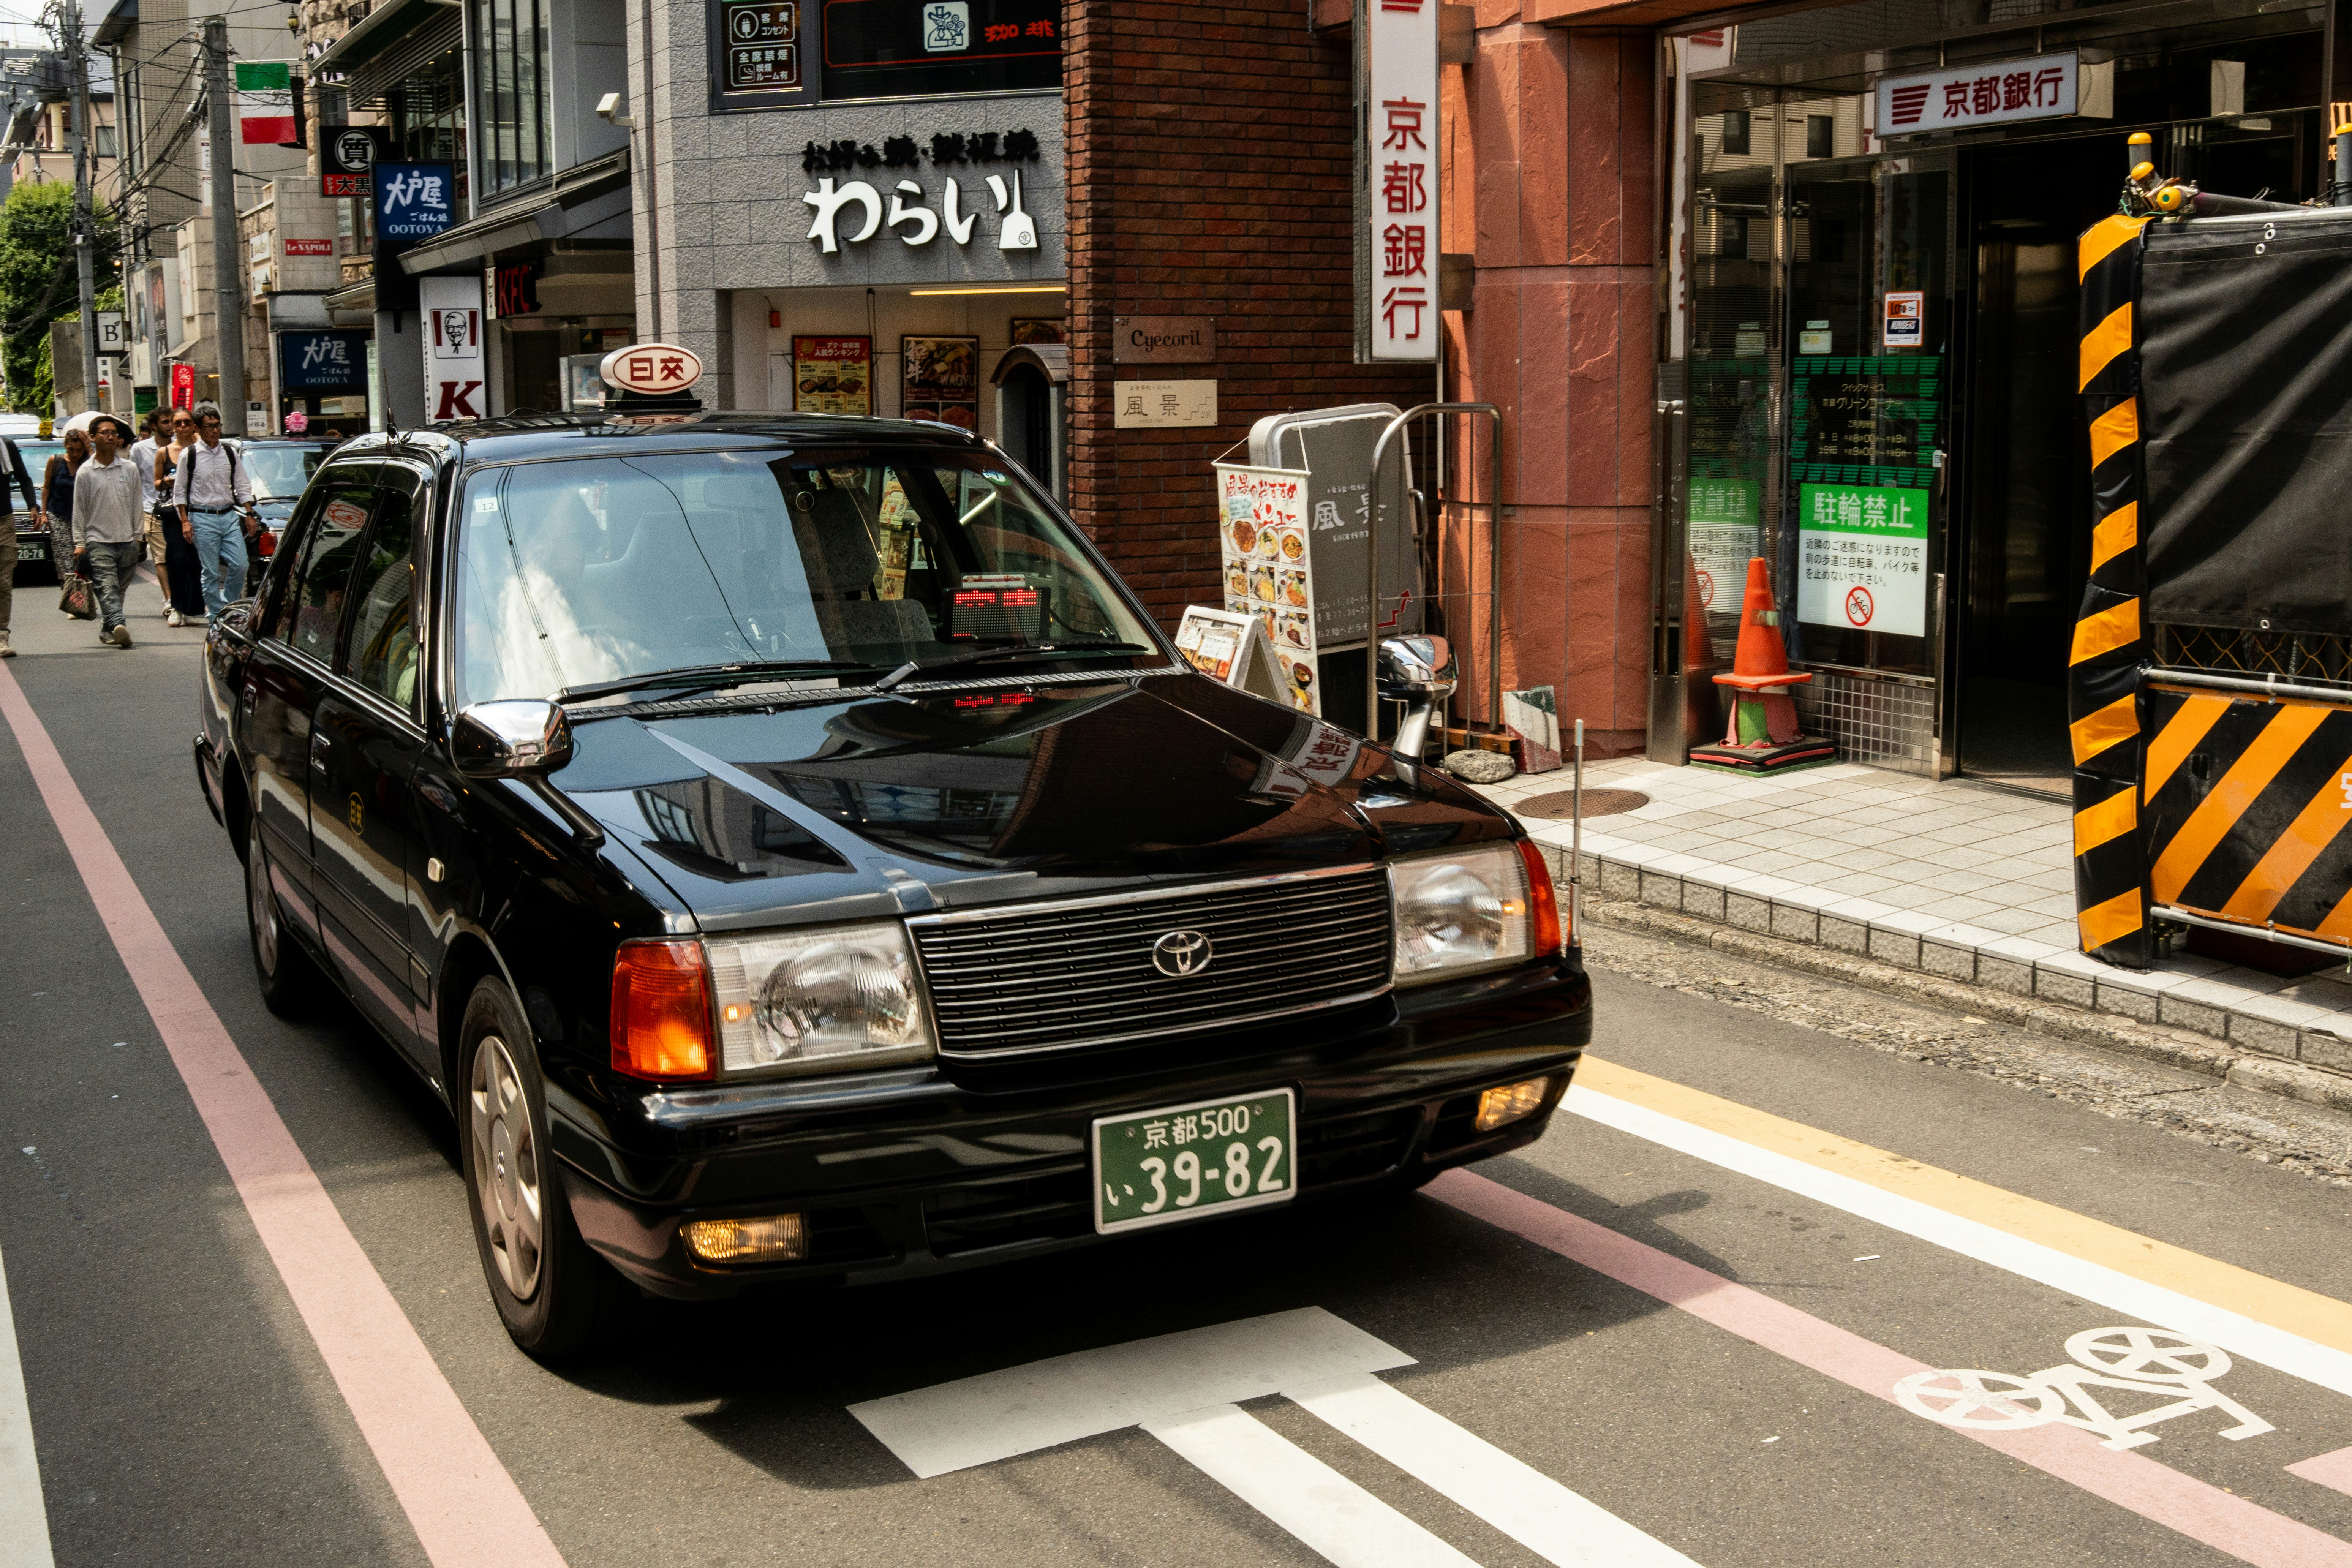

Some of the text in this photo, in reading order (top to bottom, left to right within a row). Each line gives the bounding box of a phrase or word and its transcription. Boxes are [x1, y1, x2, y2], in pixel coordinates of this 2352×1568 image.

[761, 25, 789, 36] コンセント
[738, 49, 788, 63] 全席禁煙
[756, 71, 788, 81] ルーム有
[1943, 68, 2063, 118] 京都銀行
[341, 136, 370, 165] 質
[389, 224, 444, 234] OOTOYA
[1382, 96, 1427, 340] 京都銀行
[498, 265, 529, 316] KFC
[103, 325, 118, 341] B
[1131, 330, 1201, 352] Cyecoril
[629, 356, 684, 381] 日交
[435, 381, 482, 419] K
[1123, 394, 1179, 416] 風景
[1813, 492, 1913, 528] 駐輪禁止
[17, 549, 44, 559] 20-78
[1806, 538, 1919, 558] 近隣のご迷惑になりますので
[1805, 553, 1919, 574] 前の歩道に自転車、バイク等
[1805, 567, 1888, 587] を止めないで下さい。
[1143, 1105, 1250, 1151] 京都500
[1106, 1136, 1283, 1213] い 39-82
